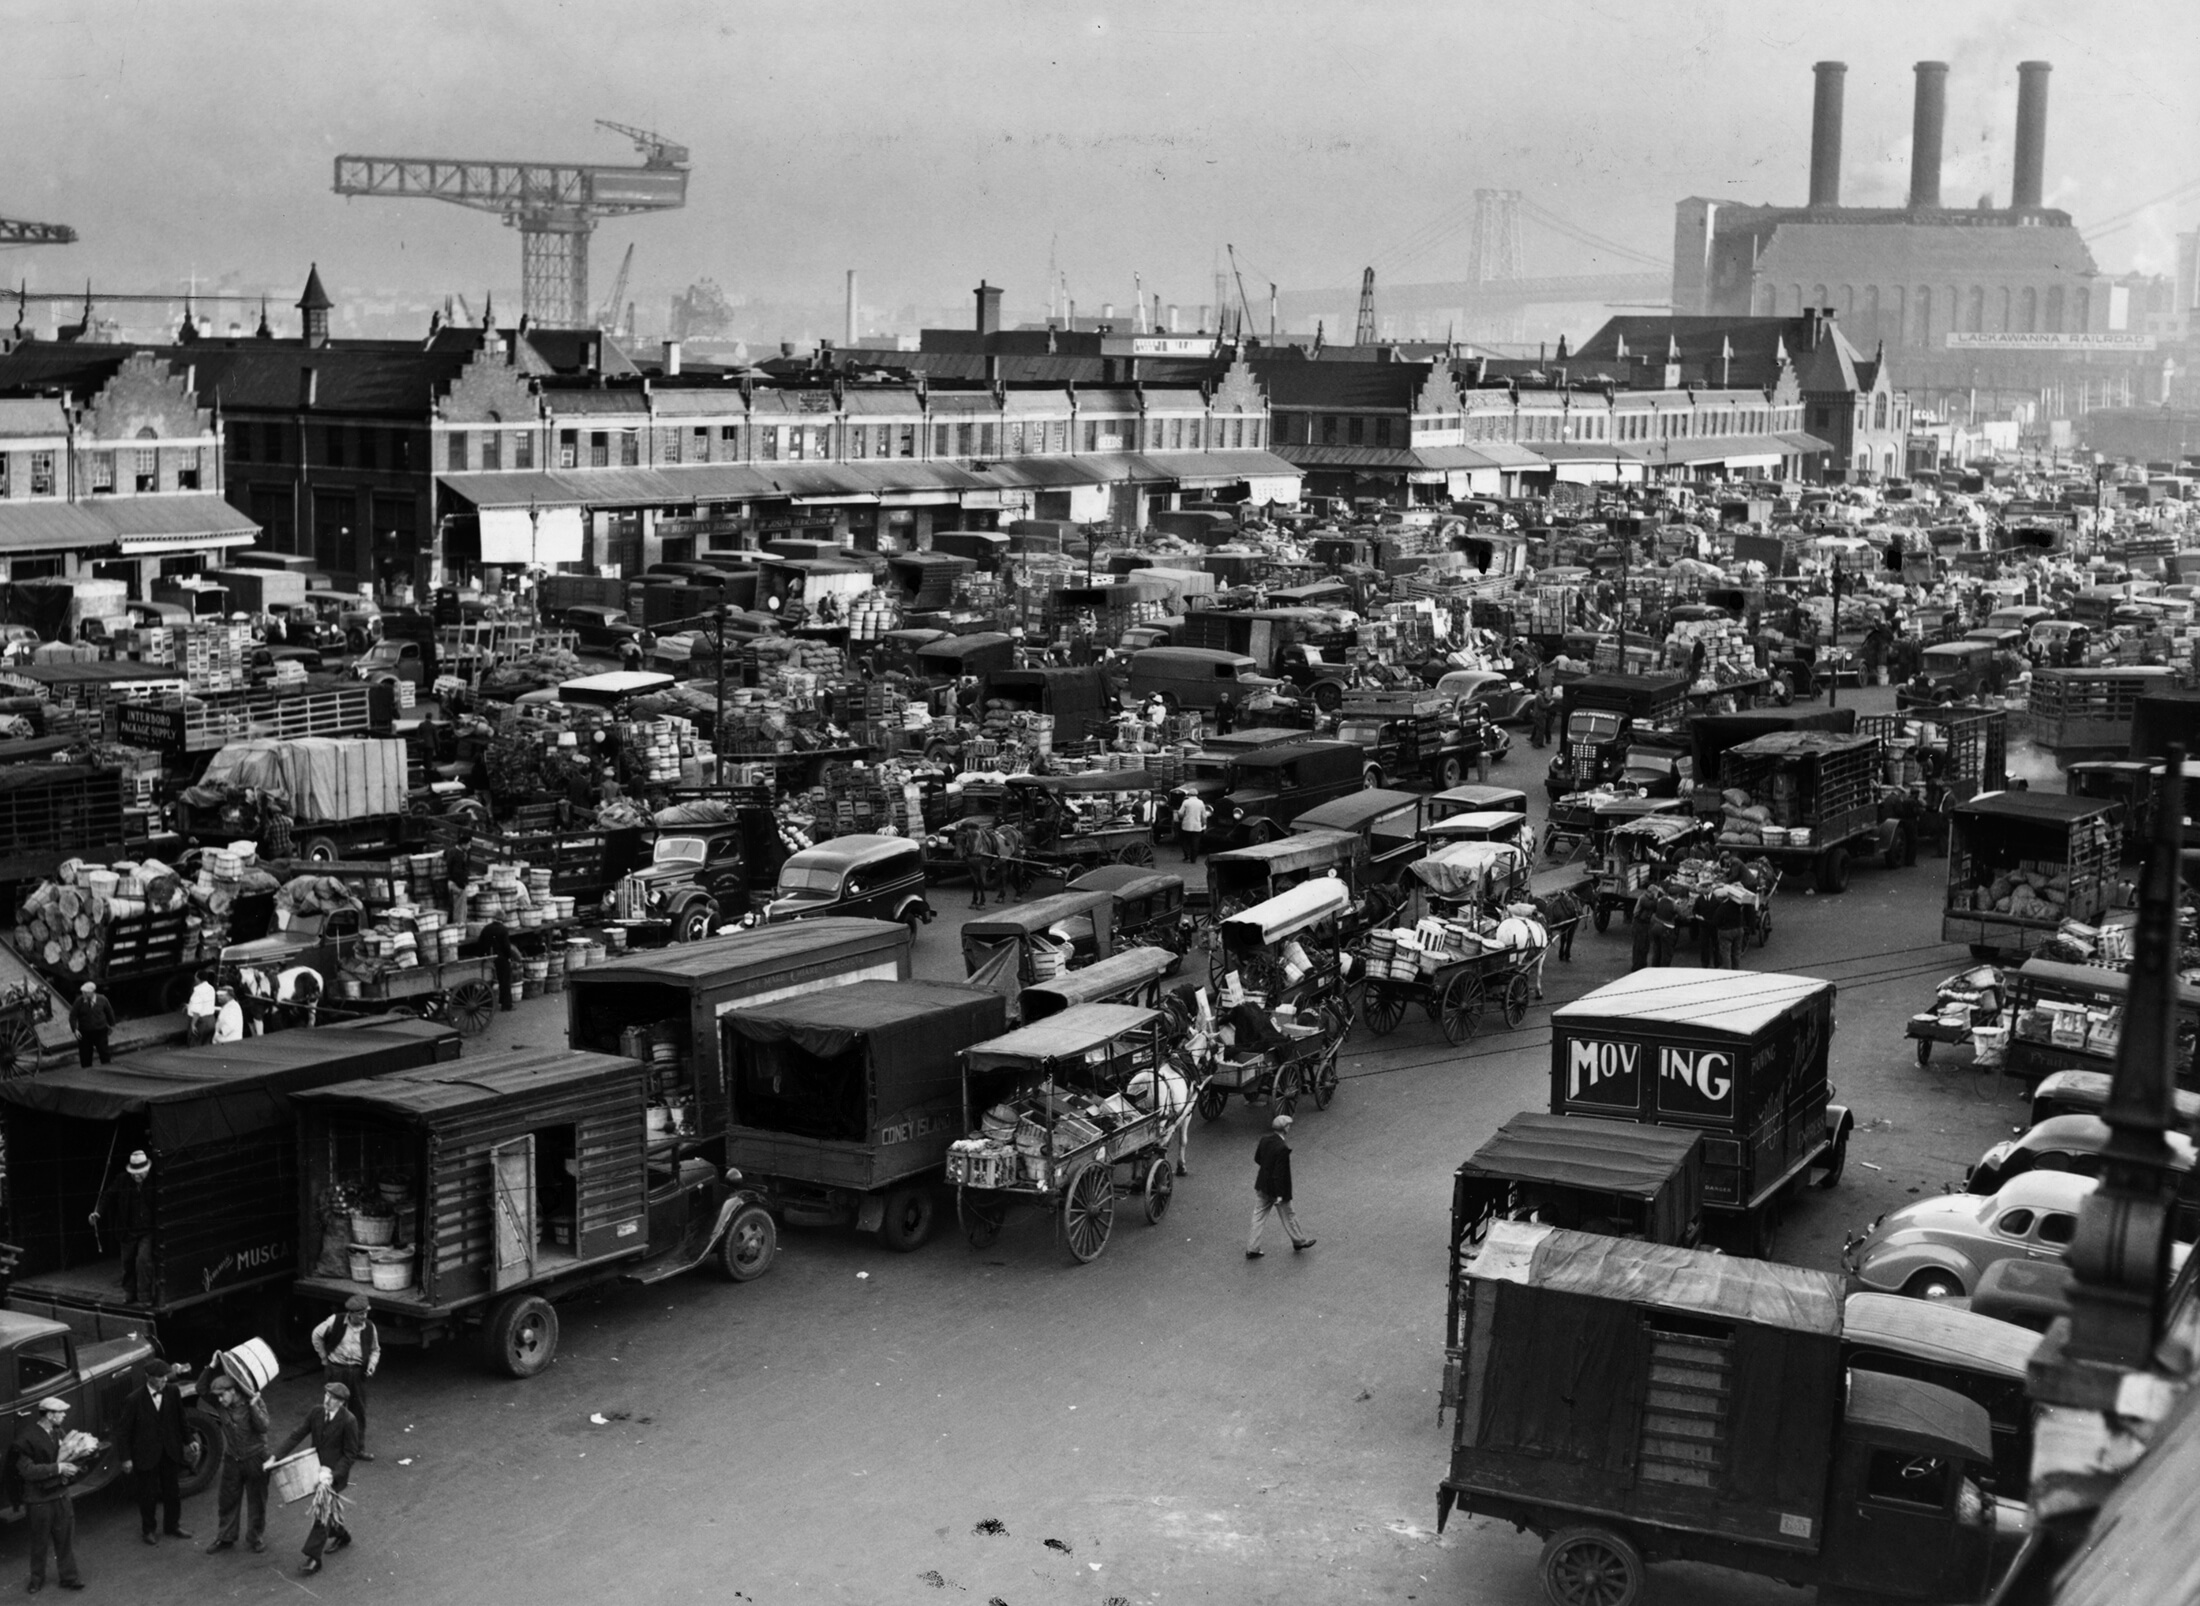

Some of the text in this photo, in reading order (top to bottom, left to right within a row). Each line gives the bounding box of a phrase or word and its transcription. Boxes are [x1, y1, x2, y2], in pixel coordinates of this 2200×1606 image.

[1957, 333, 2145, 344] LACKAWANNA RAILROAD
[1098, 435, 1123, 449] SEEDS
[127, 709, 172, 727] INTERBORO
[120, 721, 177, 741] PACKAGE SUPPLY
[1568, 1040, 1638, 1100] MOV
[1660, 1048, 1731, 1101] ING
[881, 1116, 952, 1146] CONEY ISLAND
[1704, 1184, 1732, 1193] DANGER
[236, 1239, 290, 1271] MUSCA
